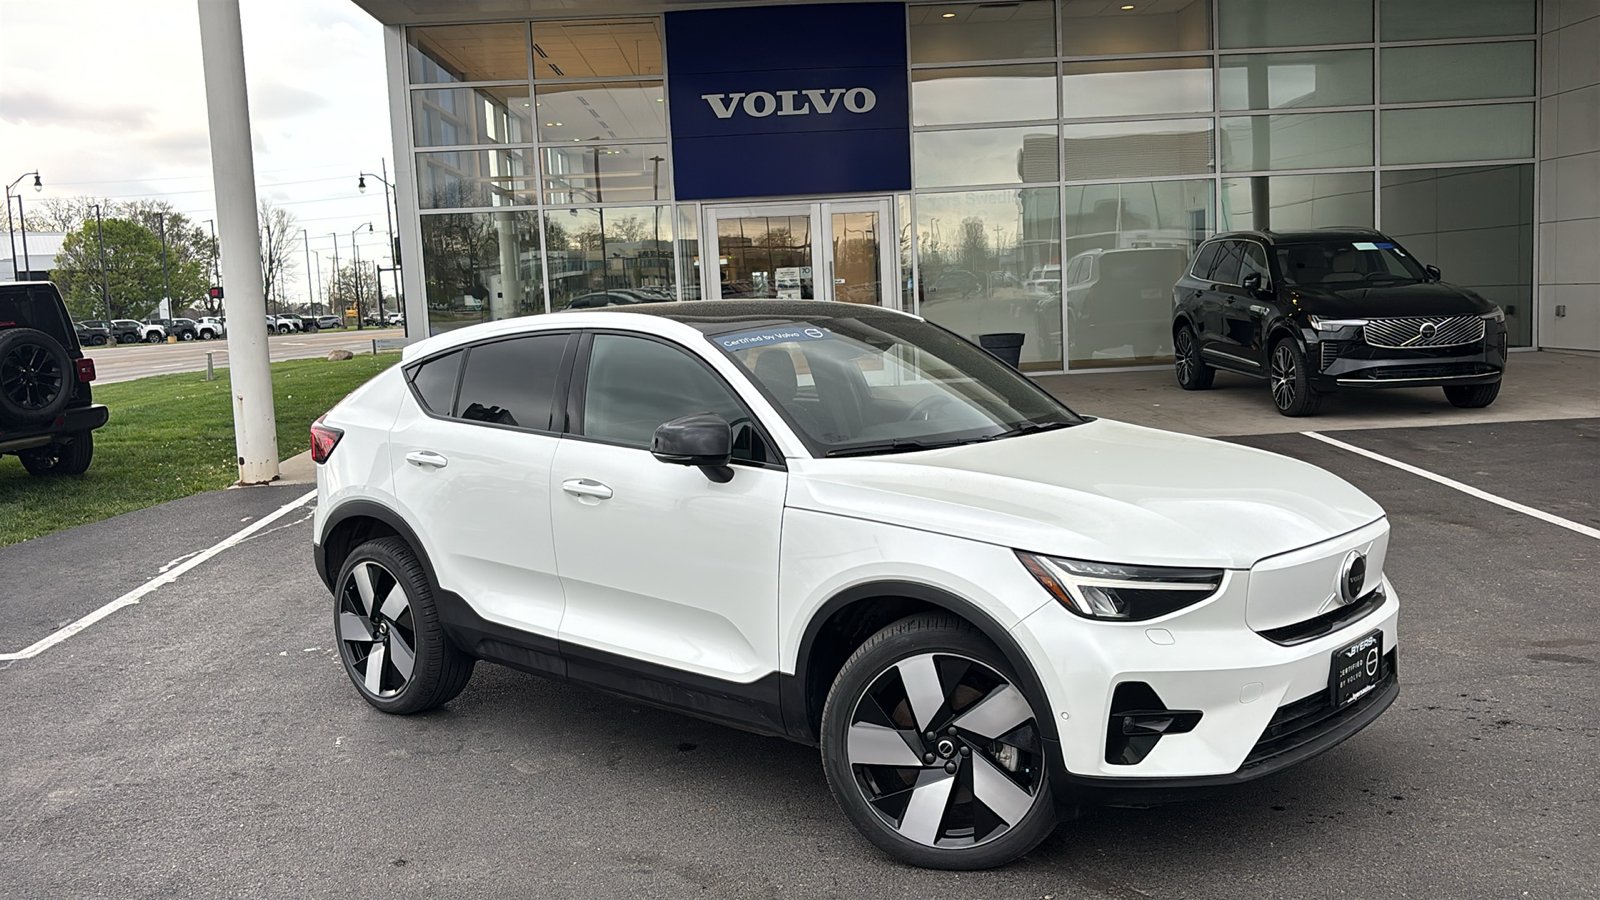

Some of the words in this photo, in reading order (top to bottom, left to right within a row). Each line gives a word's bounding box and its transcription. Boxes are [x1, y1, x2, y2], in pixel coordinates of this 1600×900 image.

[701, 87, 877, 119] VOLVO
[723, 335, 763, 347] Certified
[763, 333, 776, 341] by
[775, 332, 800, 341] Volvo
[1350, 636, 1374, 654] BYERS
[1339, 659, 1363, 678] CERTIFIED
[1340, 680, 1346, 689] BY
[1347, 671, 1362, 684] VOLVO
